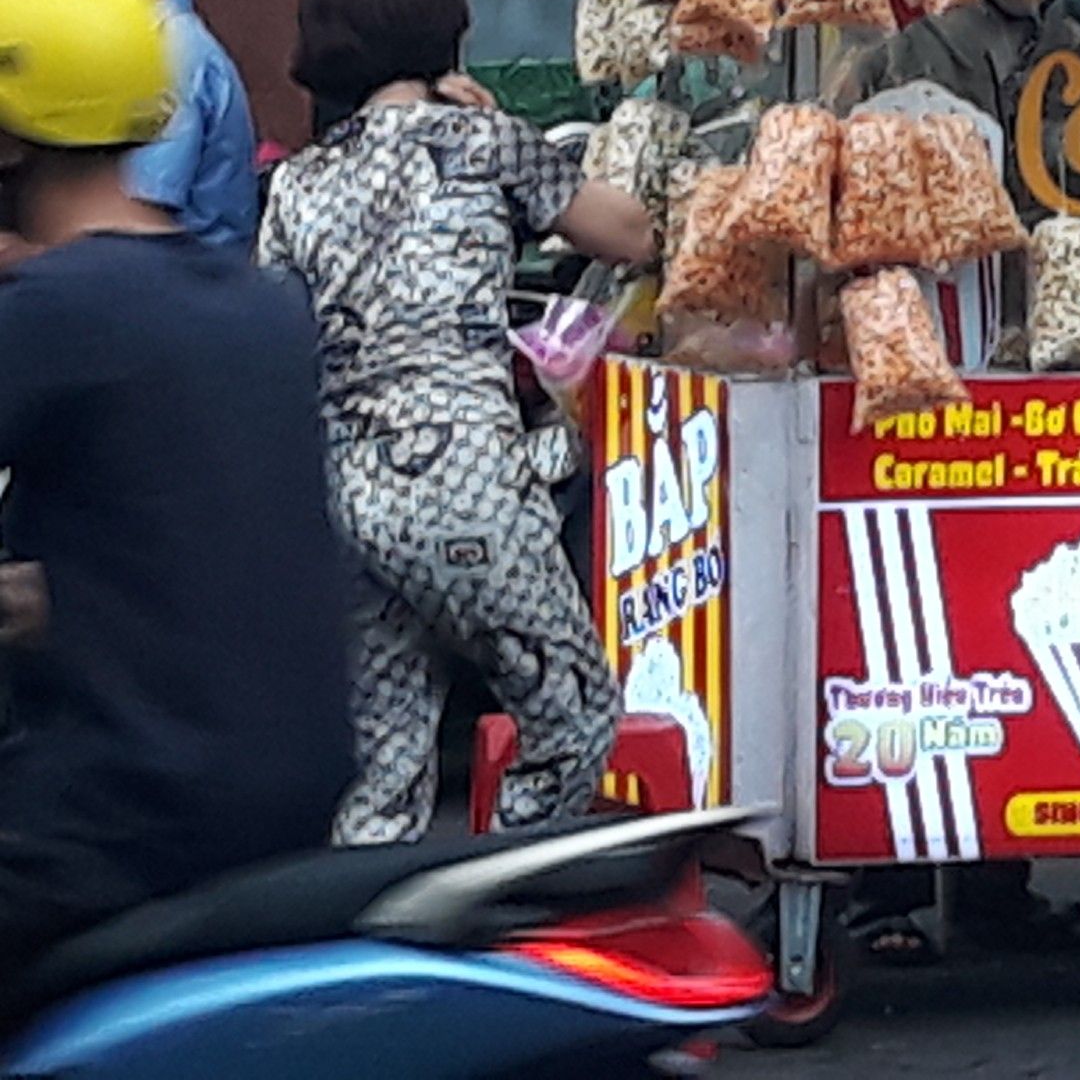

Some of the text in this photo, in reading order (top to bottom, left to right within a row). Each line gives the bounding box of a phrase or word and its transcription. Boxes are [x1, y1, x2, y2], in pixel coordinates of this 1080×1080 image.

[605, 366, 718, 578] BẮP
[874, 453, 1005, 490] Caramel
[620, 566, 688, 641] RANG
[832, 719, 917, 779] 20
